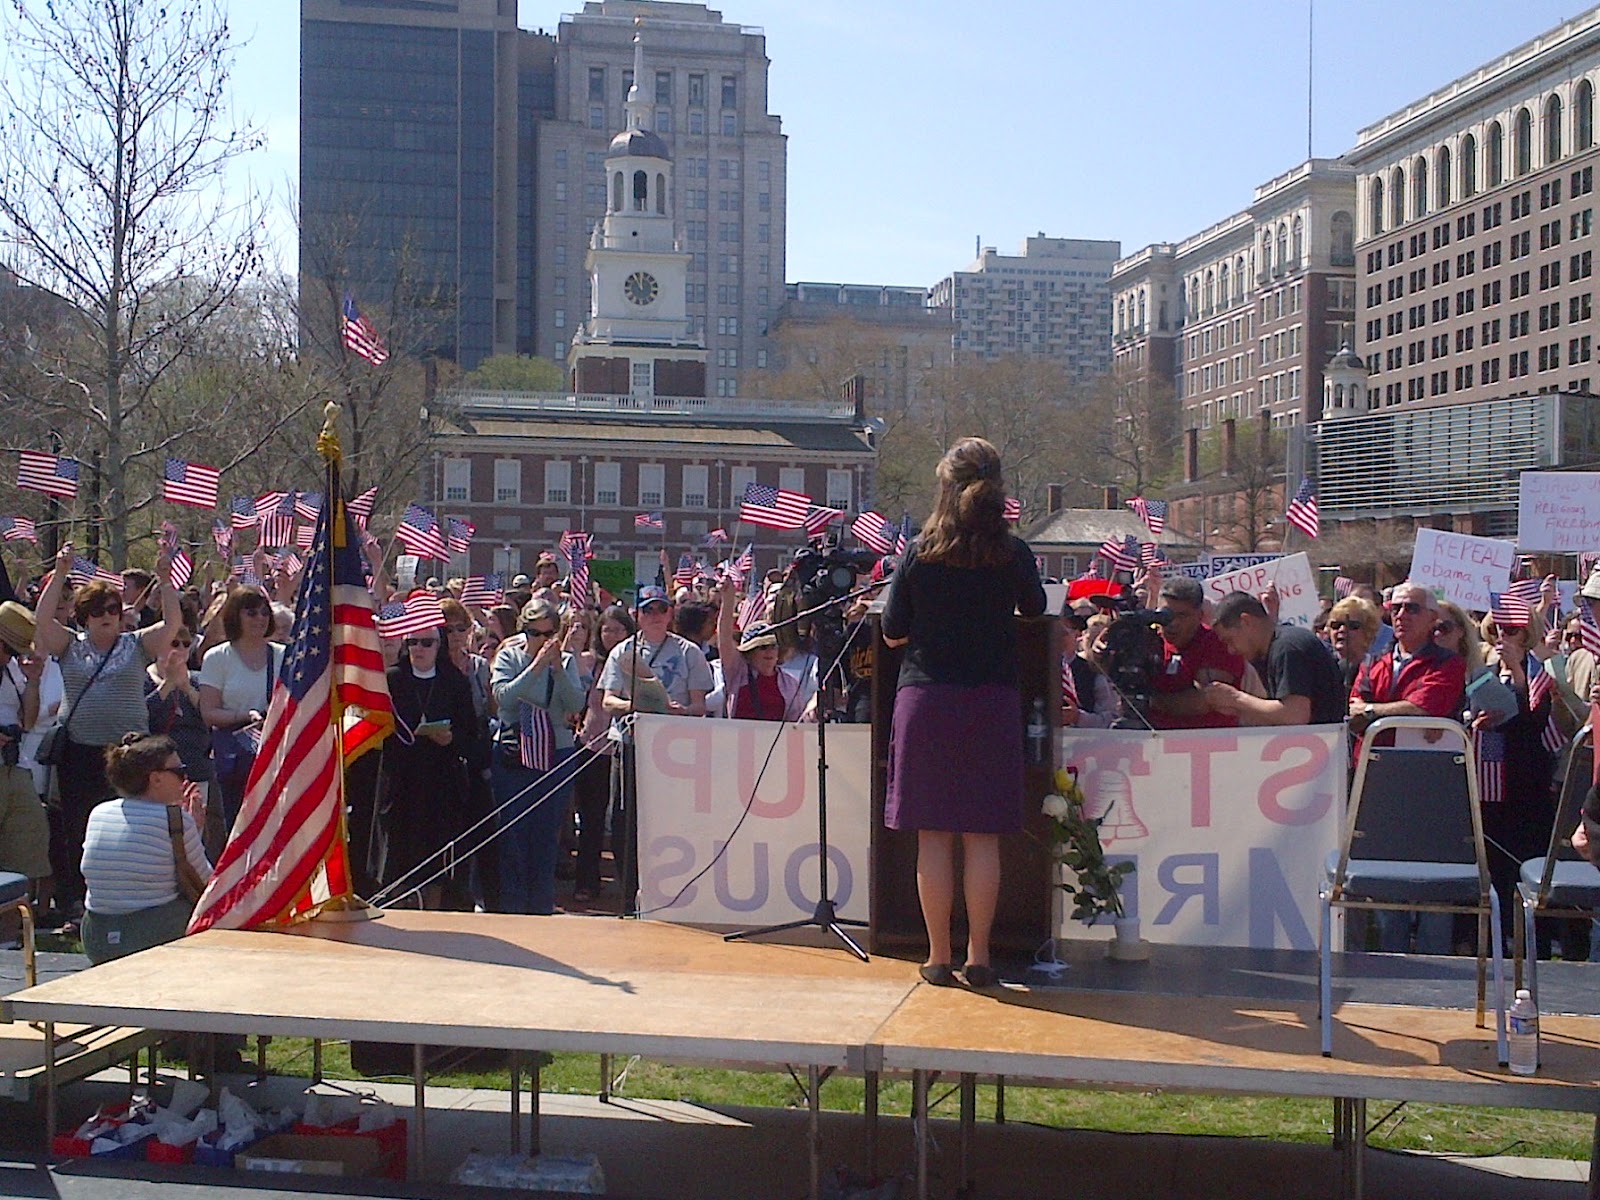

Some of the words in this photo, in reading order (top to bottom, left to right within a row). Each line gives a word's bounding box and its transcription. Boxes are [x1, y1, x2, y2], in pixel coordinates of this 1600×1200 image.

[1433, 534, 1510, 569] REPEAL
[1182, 565, 1210, 578] STAN
[1211, 568, 1266, 602] STOP
